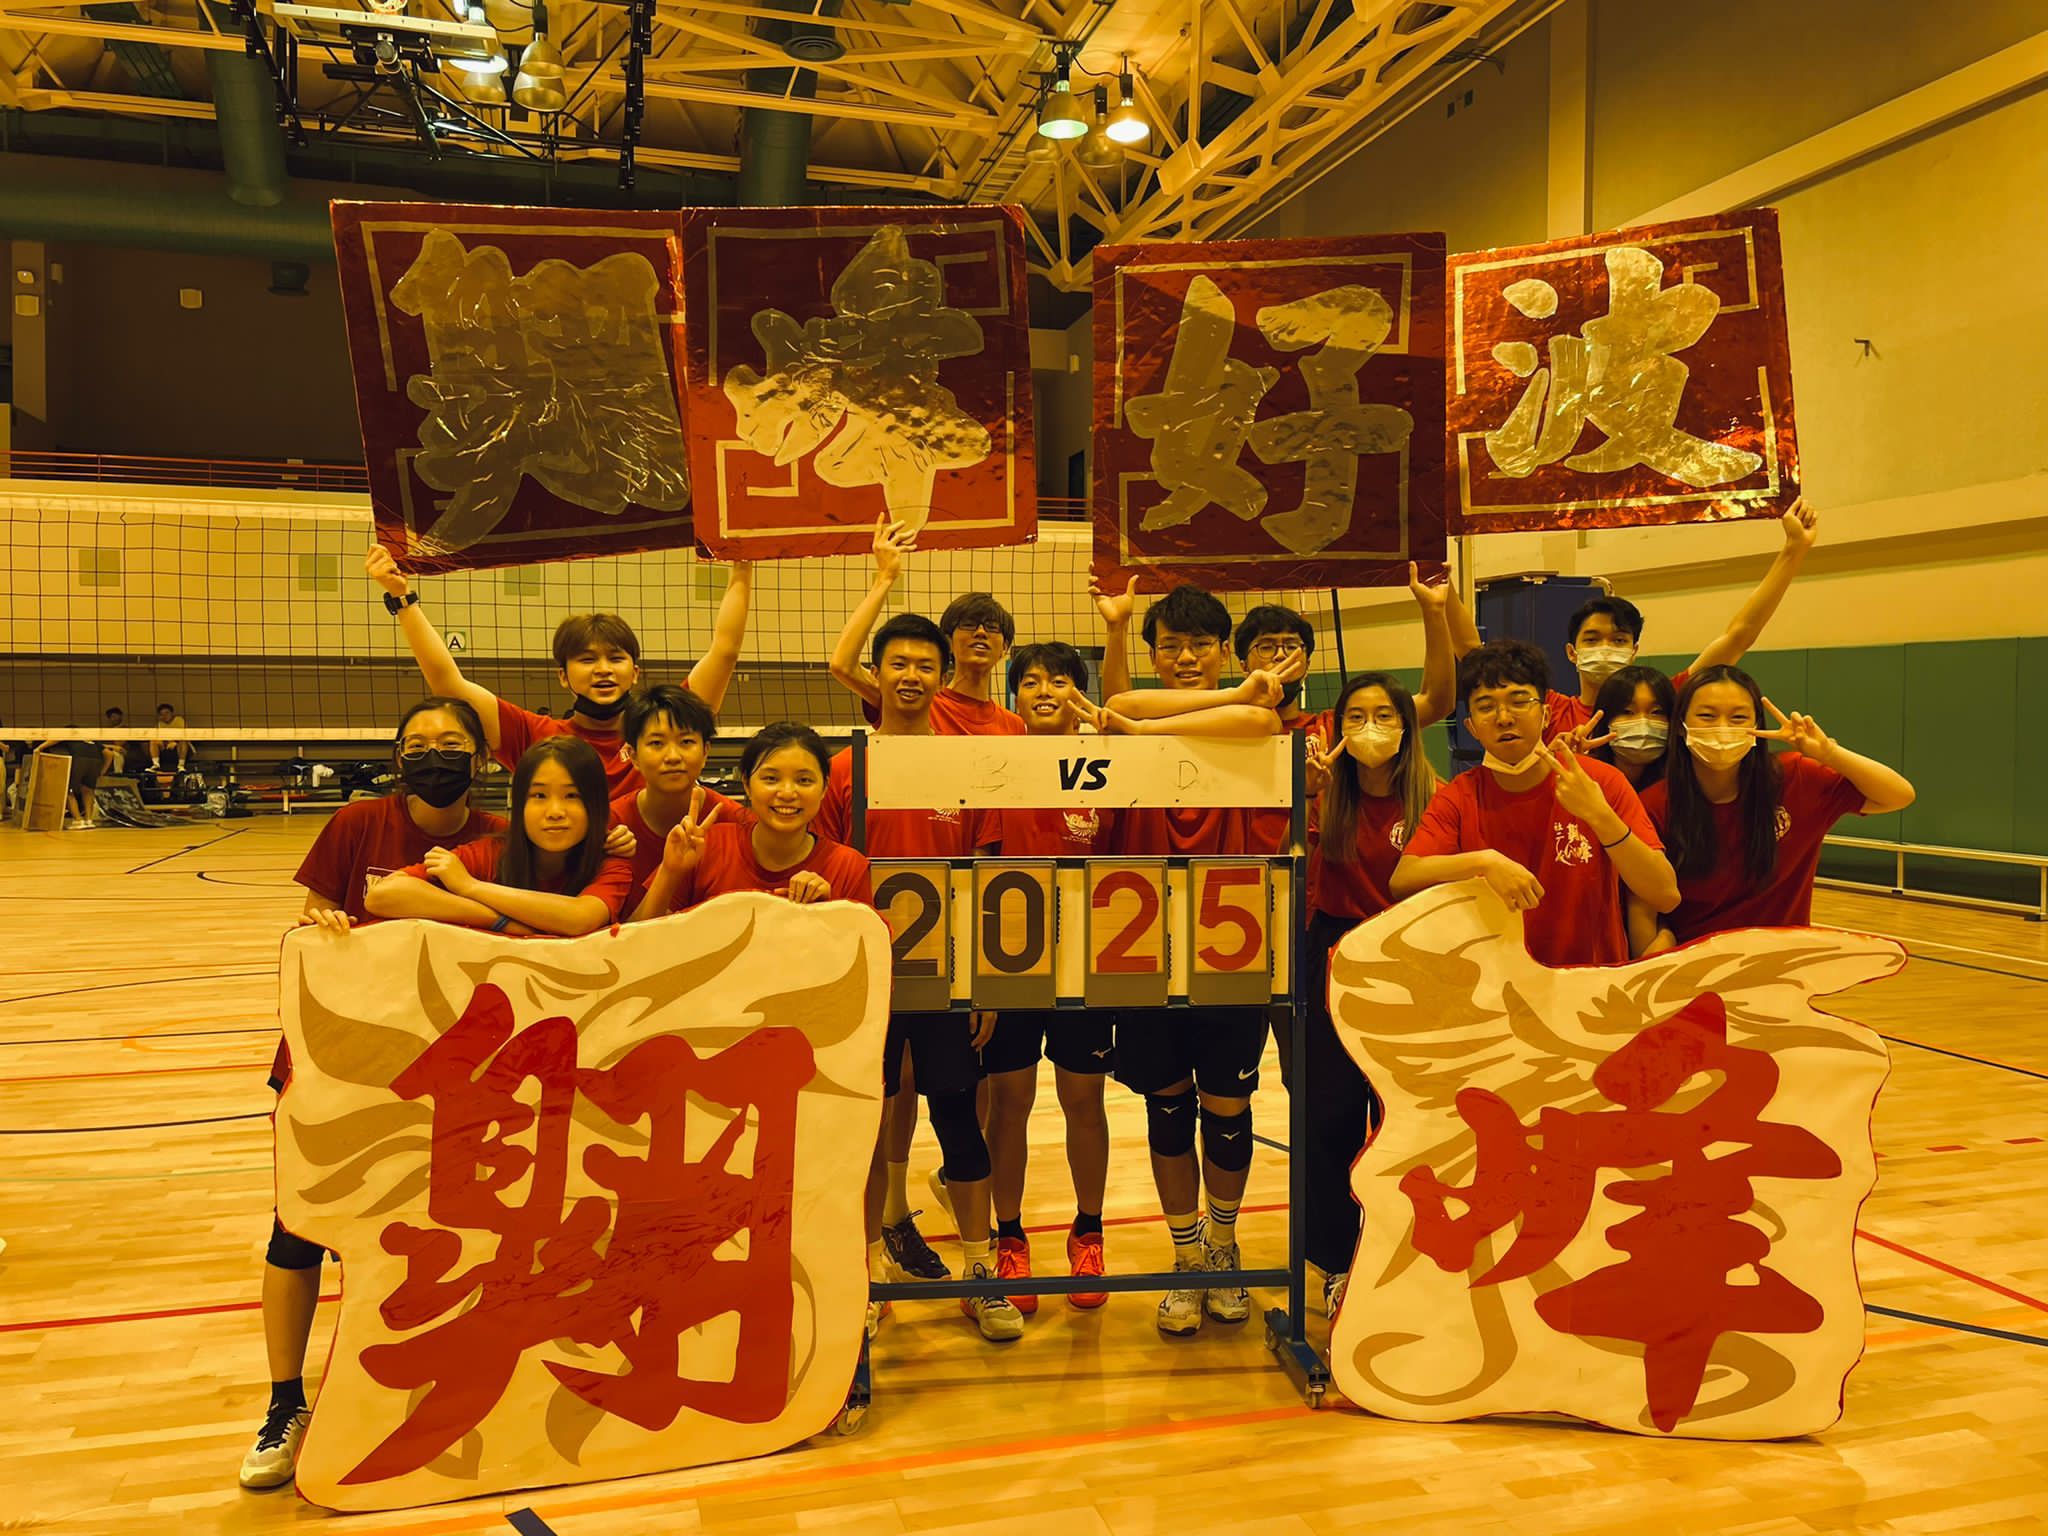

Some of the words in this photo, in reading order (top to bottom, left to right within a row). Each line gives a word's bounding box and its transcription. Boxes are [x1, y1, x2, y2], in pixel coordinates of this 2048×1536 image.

[1124, 274, 1415, 557] 好
[1485, 246, 1763, 487] 波
[449, 635, 462, 649] A
[1058, 757, 1111, 791] VS
